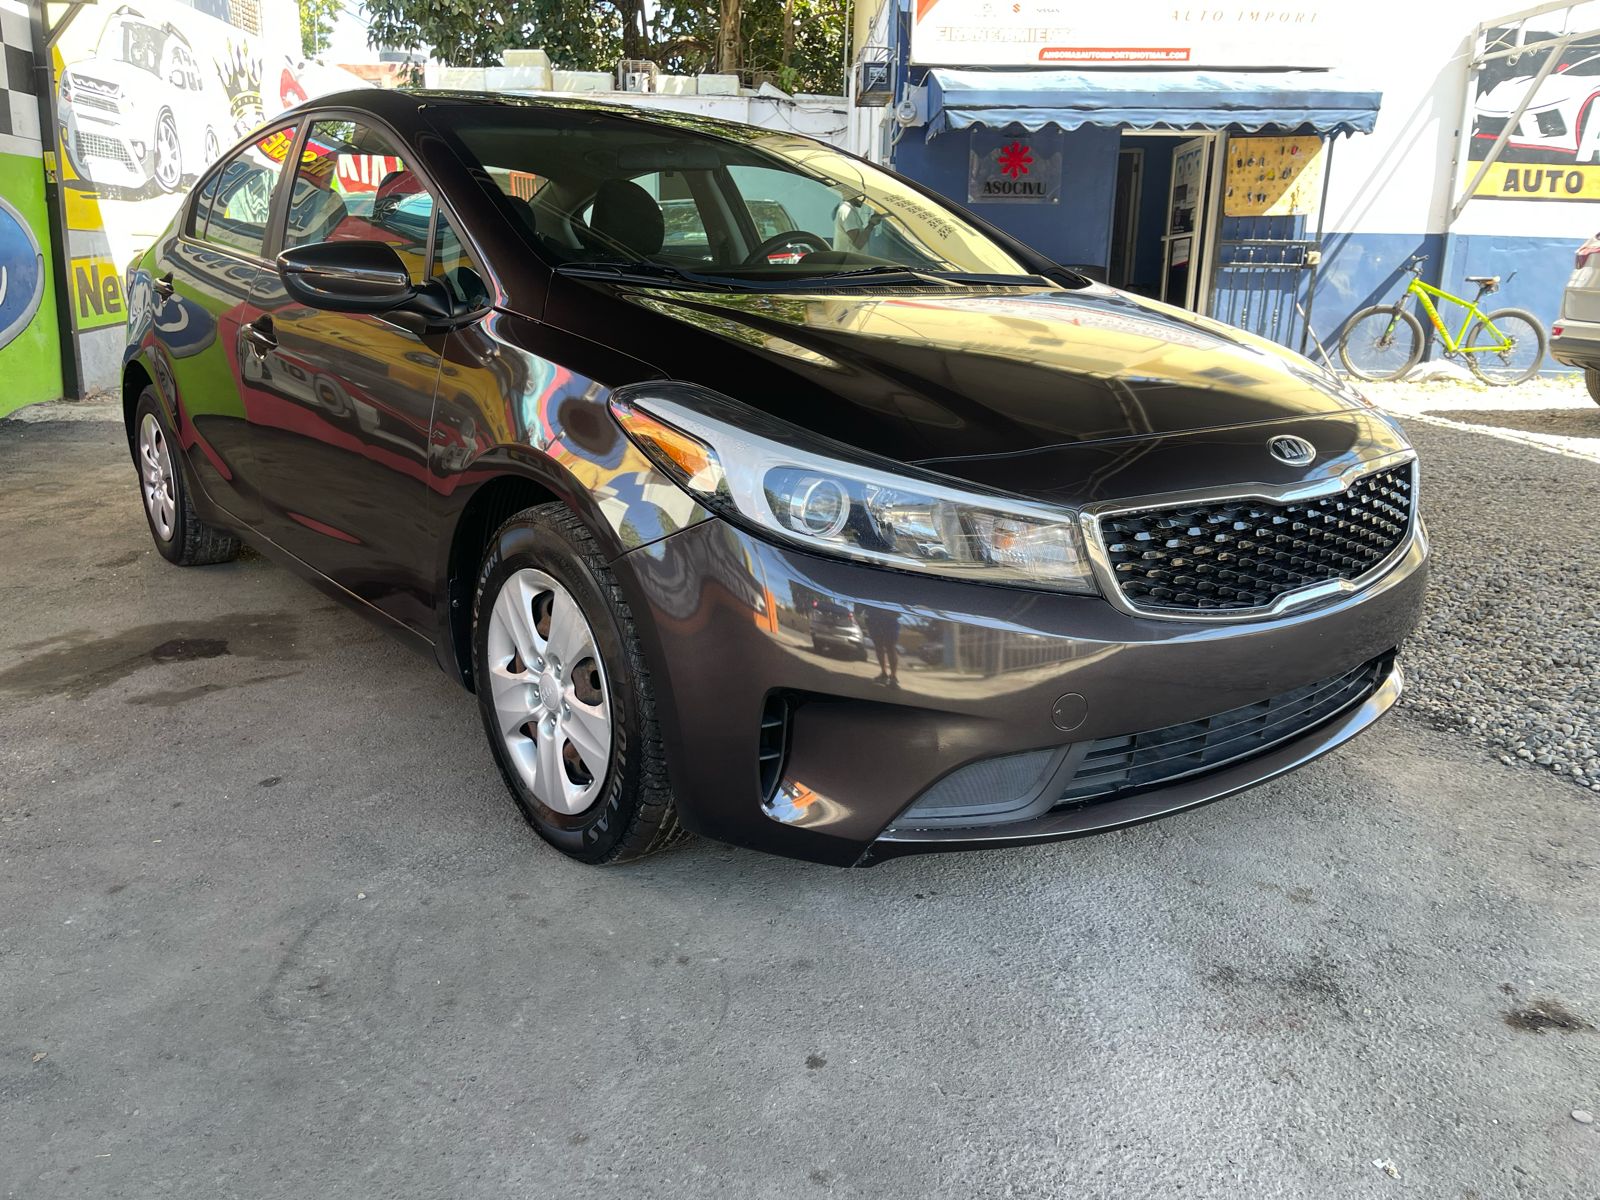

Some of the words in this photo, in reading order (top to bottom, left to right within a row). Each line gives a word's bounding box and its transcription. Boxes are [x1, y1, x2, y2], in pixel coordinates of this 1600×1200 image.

[983, 181, 1047, 195] ASOCIVU
[1503, 168, 1584, 194] AUTO
[587, 698, 627, 845] DOUGLAS
